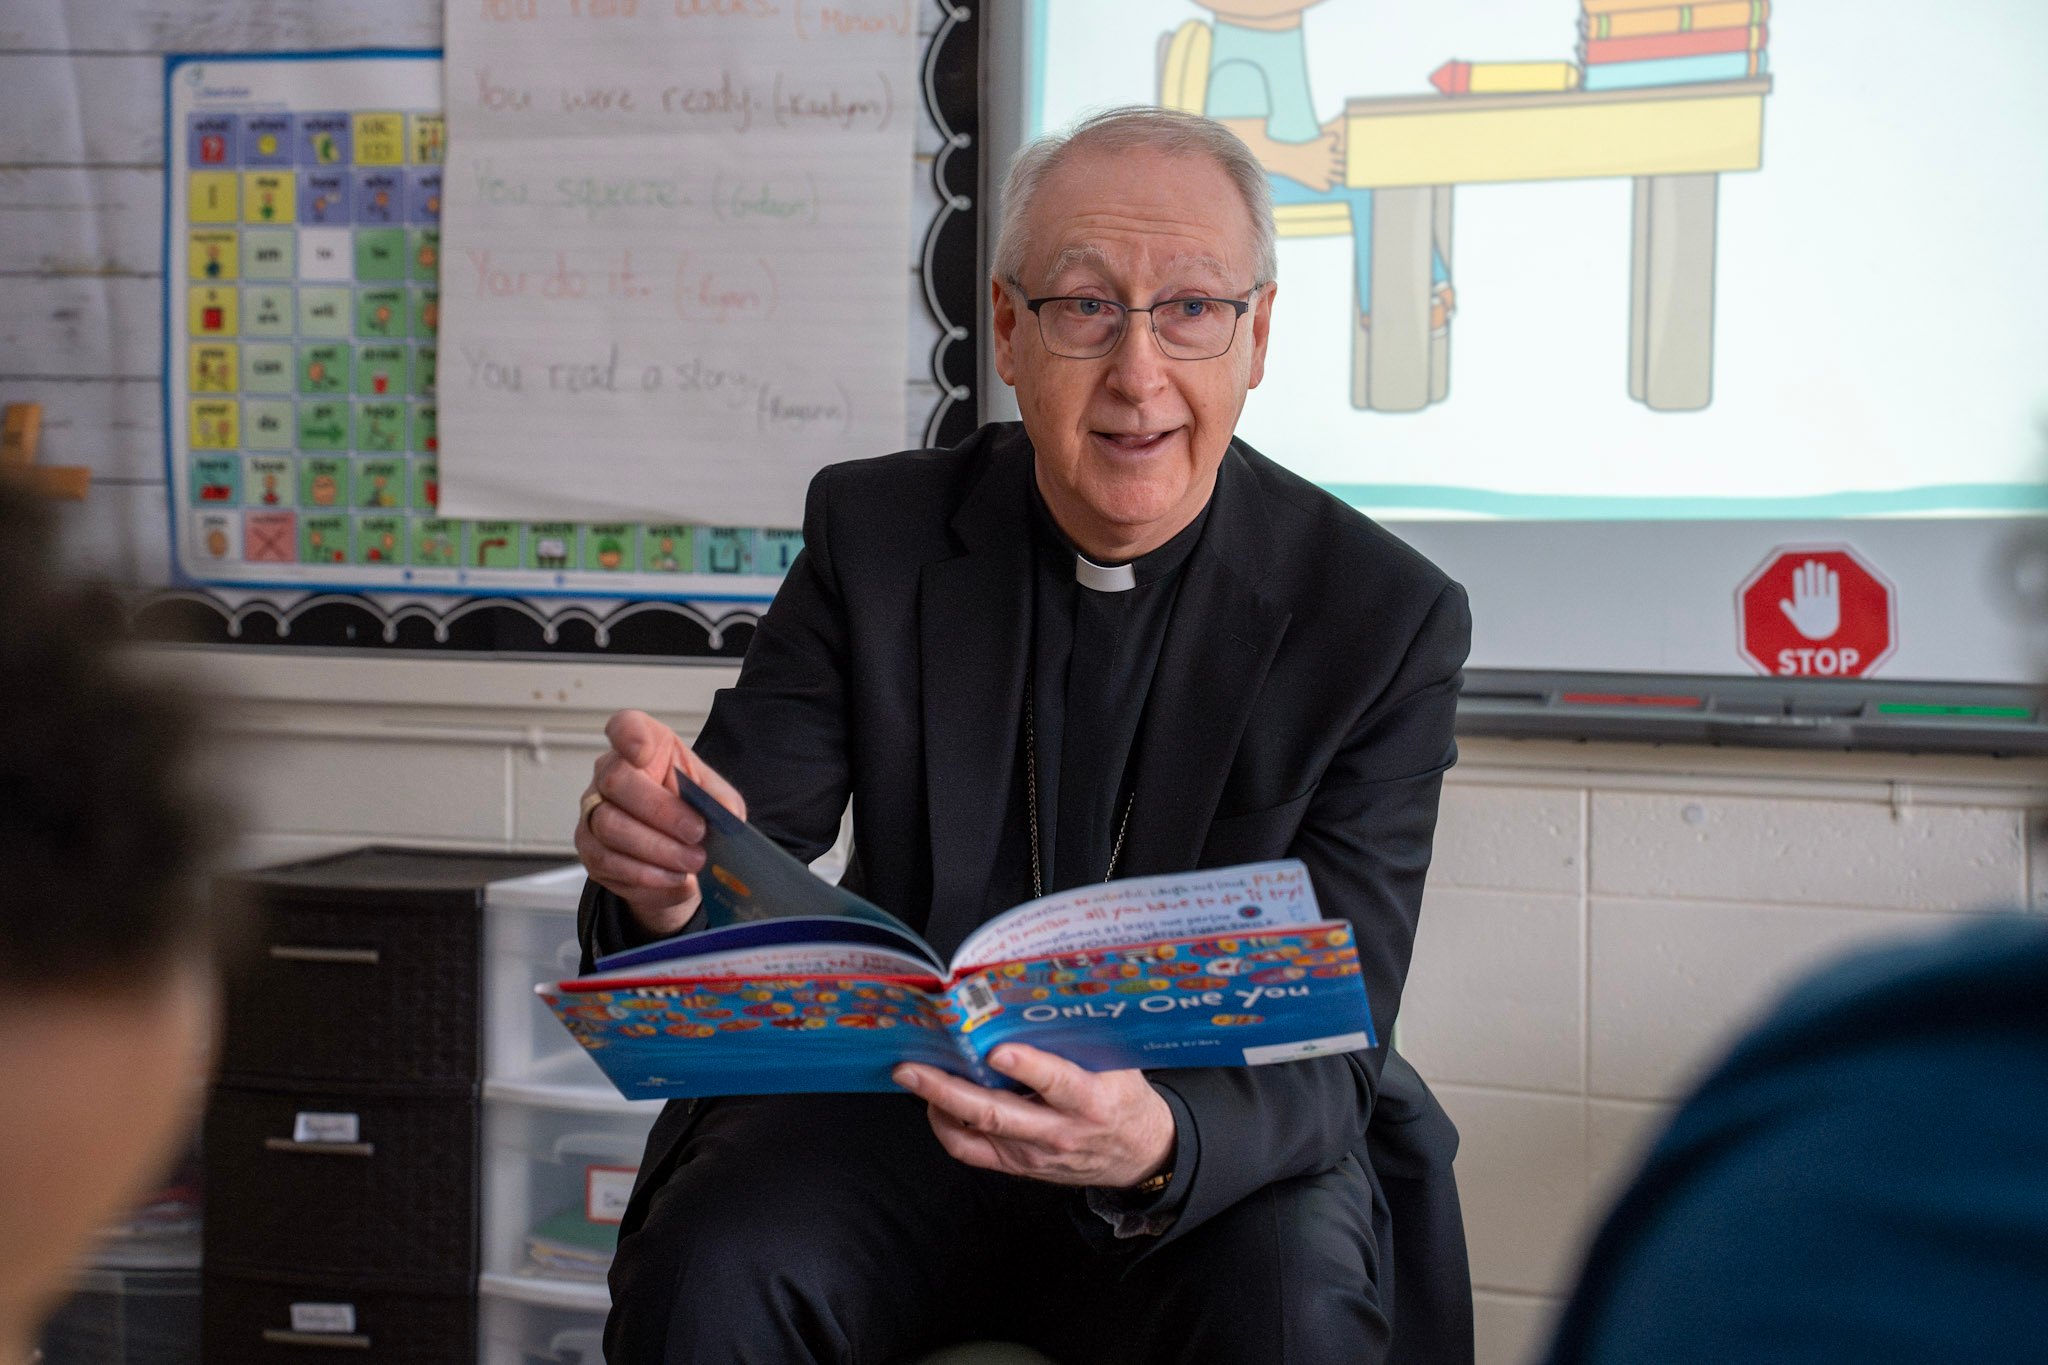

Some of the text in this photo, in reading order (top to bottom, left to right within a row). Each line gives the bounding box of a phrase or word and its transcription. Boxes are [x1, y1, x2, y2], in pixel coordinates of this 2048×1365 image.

[475, 68, 533, 111] You
[560, 88, 636, 113] were
[472, 158, 530, 205] You
[541, 250, 588, 299] do
[459, 337, 523, 392] You
[547, 342, 620, 393] read
[641, 362, 663, 391] a
[1777, 648, 1860, 675] STOP
